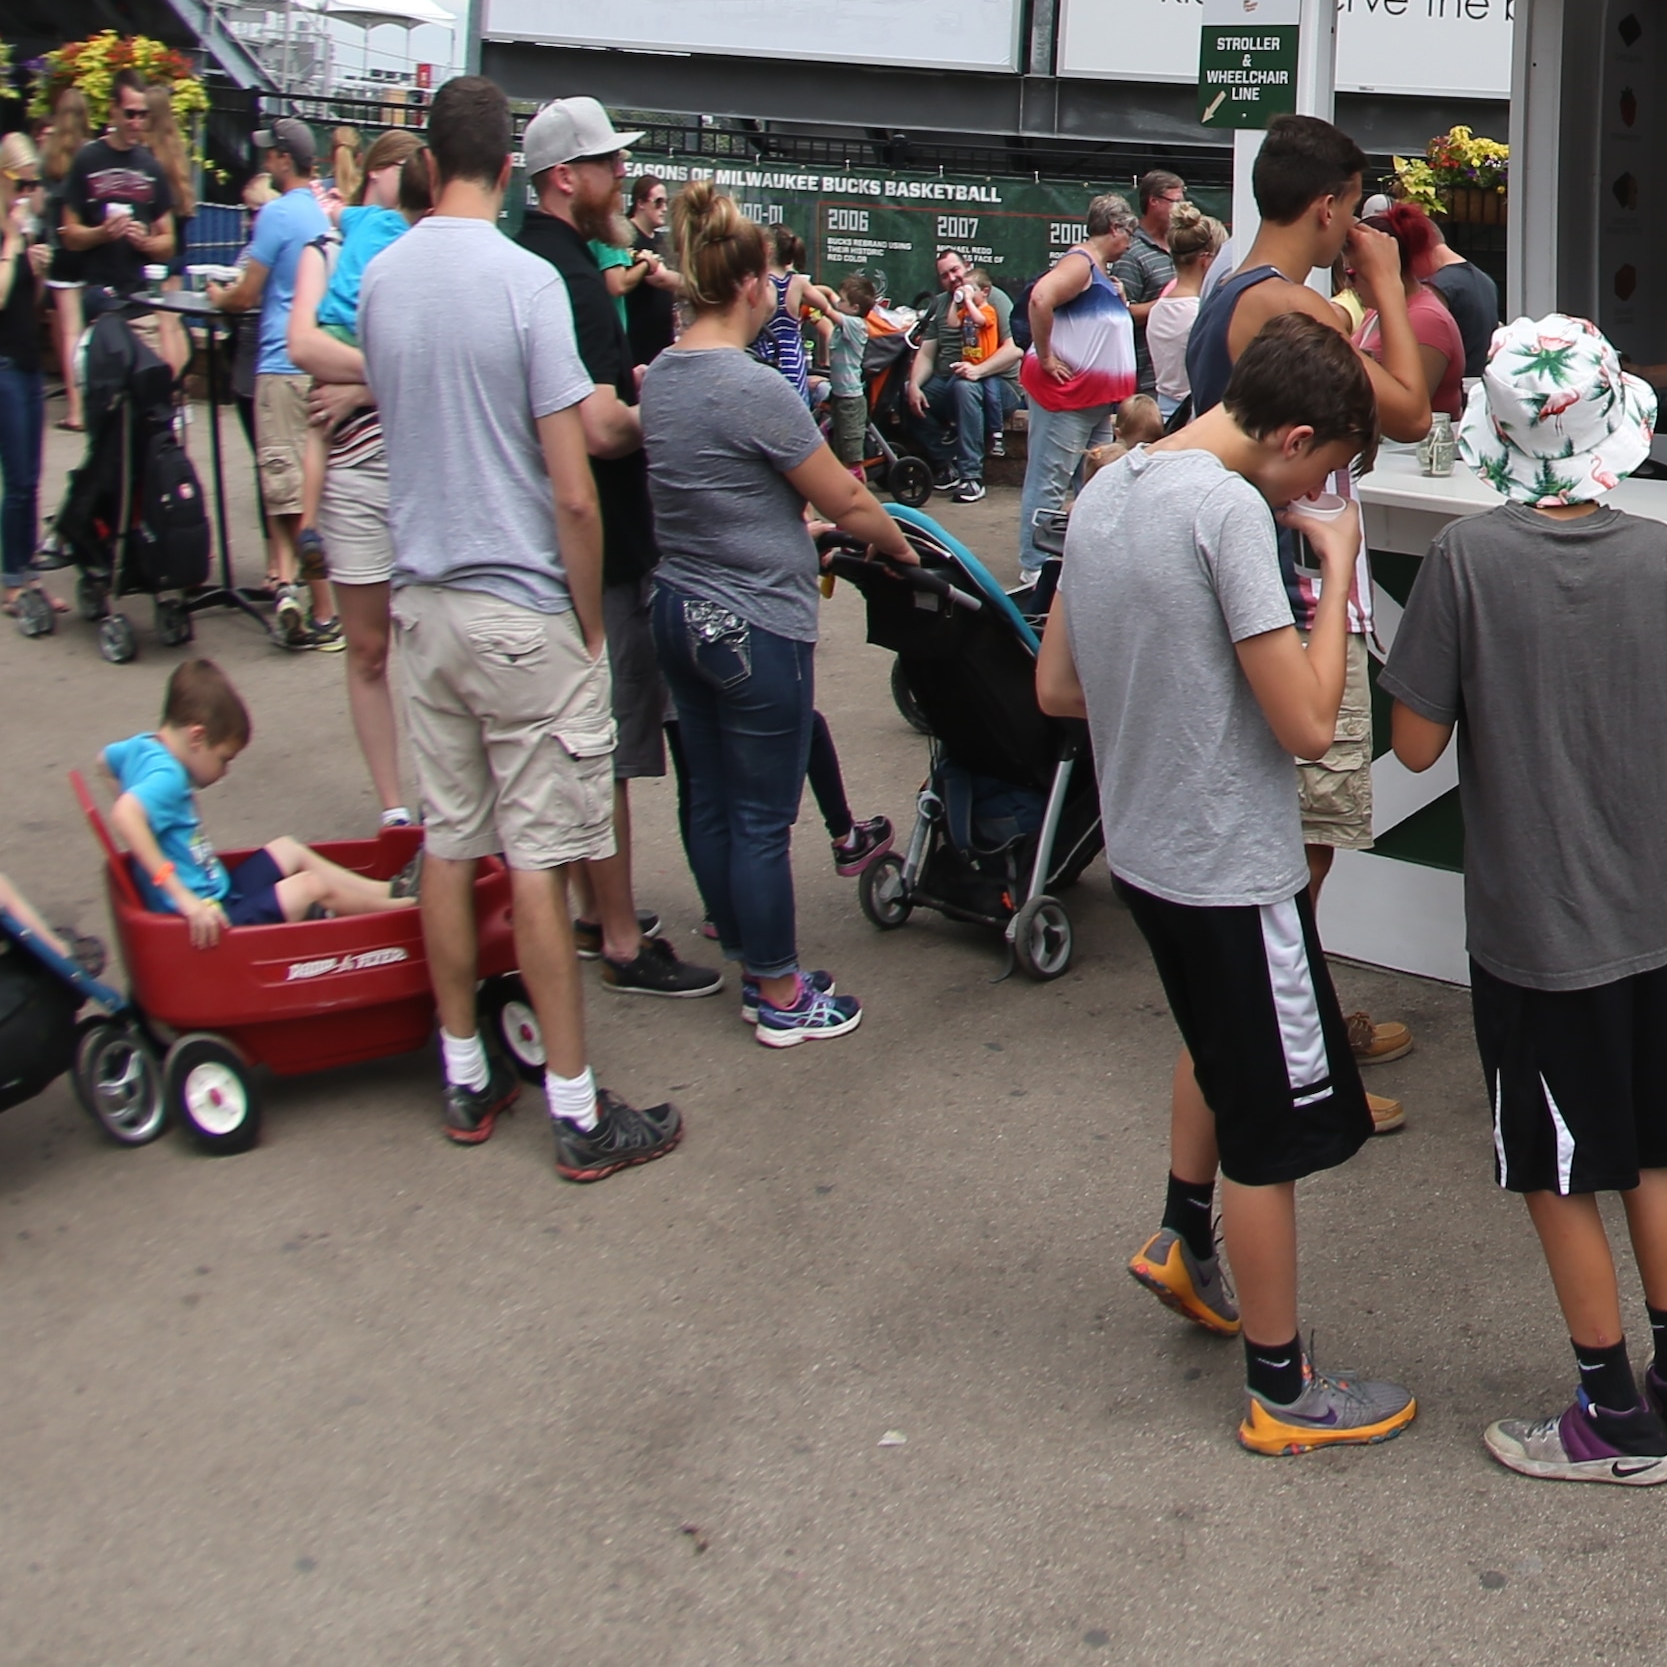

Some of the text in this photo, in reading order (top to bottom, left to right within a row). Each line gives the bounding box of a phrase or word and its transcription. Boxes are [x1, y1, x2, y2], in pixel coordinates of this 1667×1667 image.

[1216, 36, 1280, 52] STROLLER
[1242, 54, 1253, 68] &
[1206, 70, 1289, 86] WHEELCHAIR
[1231, 86, 1260, 102] LINE
[626, 162, 1002, 203] EASONS OF MILWAUKEE BUCKS BASKETBALL
[827, 208, 870, 232] 2006
[936, 215, 979, 239] 2007
[827, 238, 912, 251] BUCKS REBRAND USING
[827, 245, 885, 257] THEIR HISTORIC
[827, 253, 868, 264] RED COLOR
